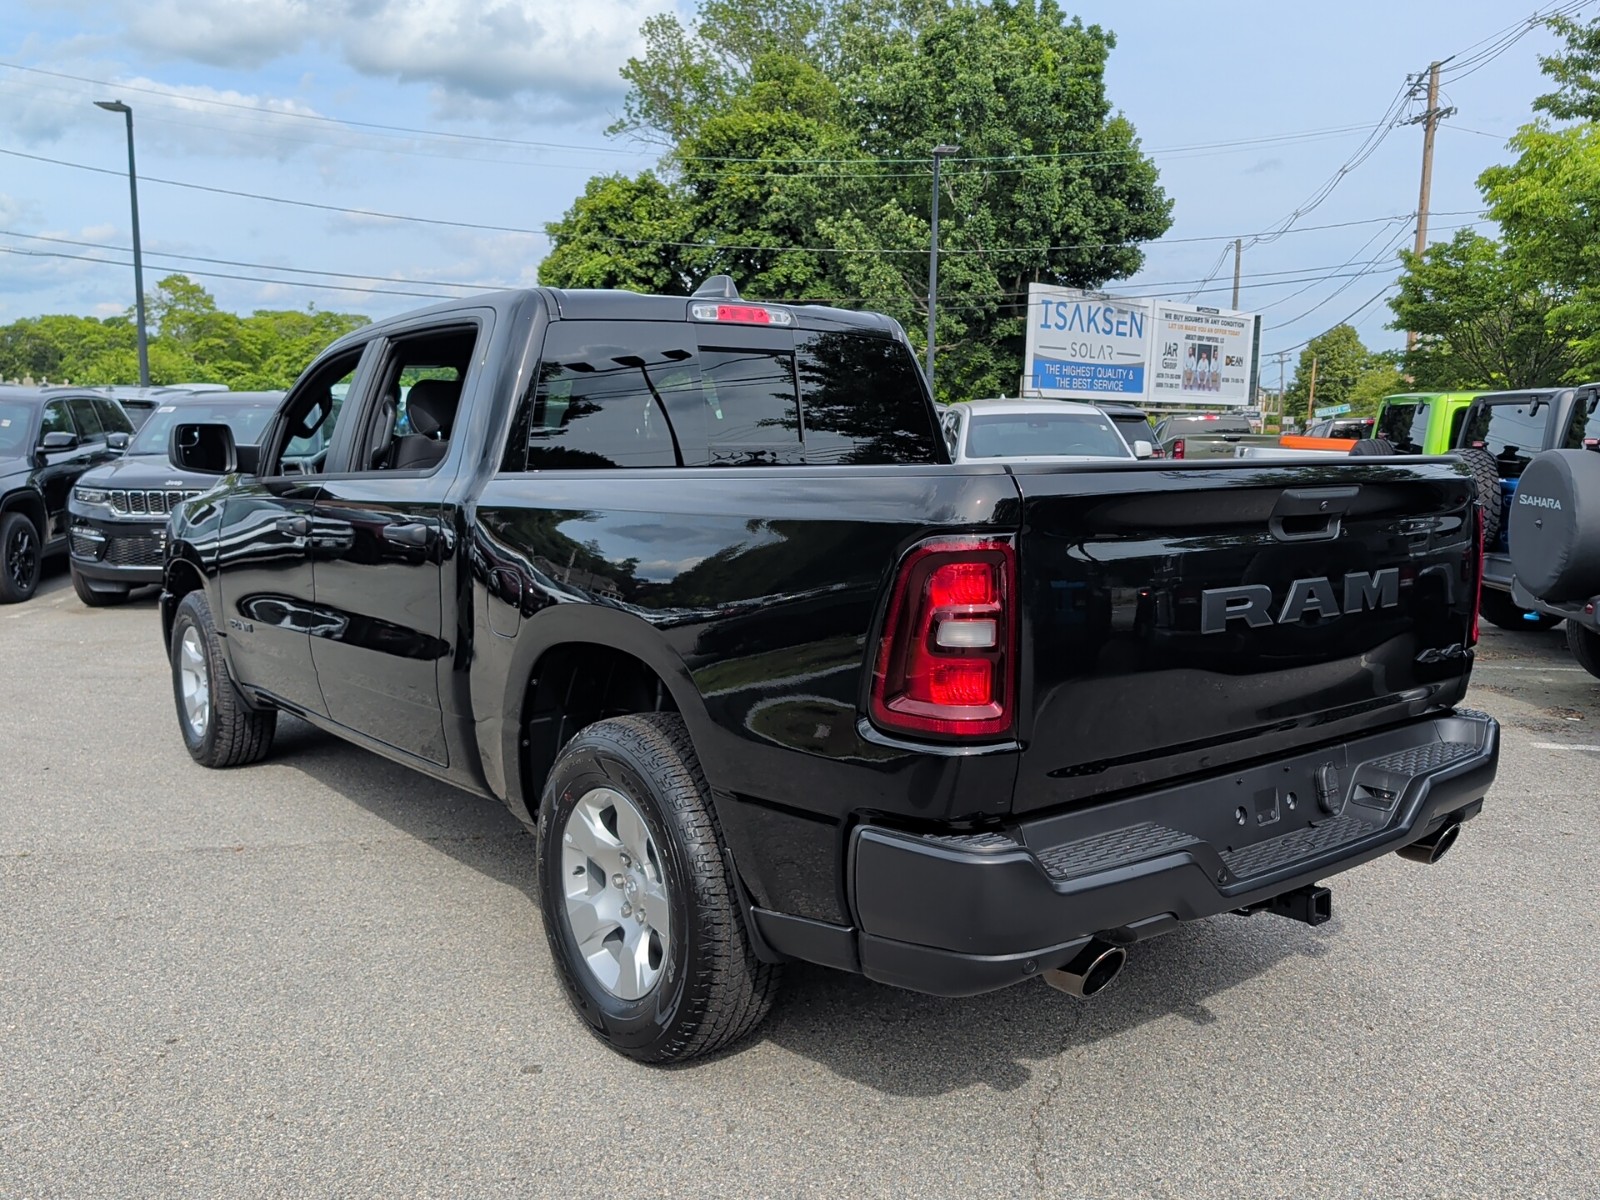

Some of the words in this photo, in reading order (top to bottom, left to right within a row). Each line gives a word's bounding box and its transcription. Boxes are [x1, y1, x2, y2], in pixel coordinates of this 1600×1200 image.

[1040, 299, 1144, 339] ISAKSEN
[1221, 320, 1244, 328] CONDITION
[1070, 341, 1114, 361] SOLAR
[1163, 342, 1178, 357] JAR
[1225, 355, 1243, 367] DEAN
[1045, 363, 1061, 376] THE
[1062, 365, 1095, 378] HIGHEST
[1096, 367, 1127, 380] QUALITY
[1128, 370, 1134, 380] &
[1056, 377, 1071, 389] THE
[1072, 378, 1092, 390] BEST
[1093, 380, 1124, 391] SERVICE
[1519, 493, 1562, 511] SAHARA
[1201, 567, 1399, 635] RAM
